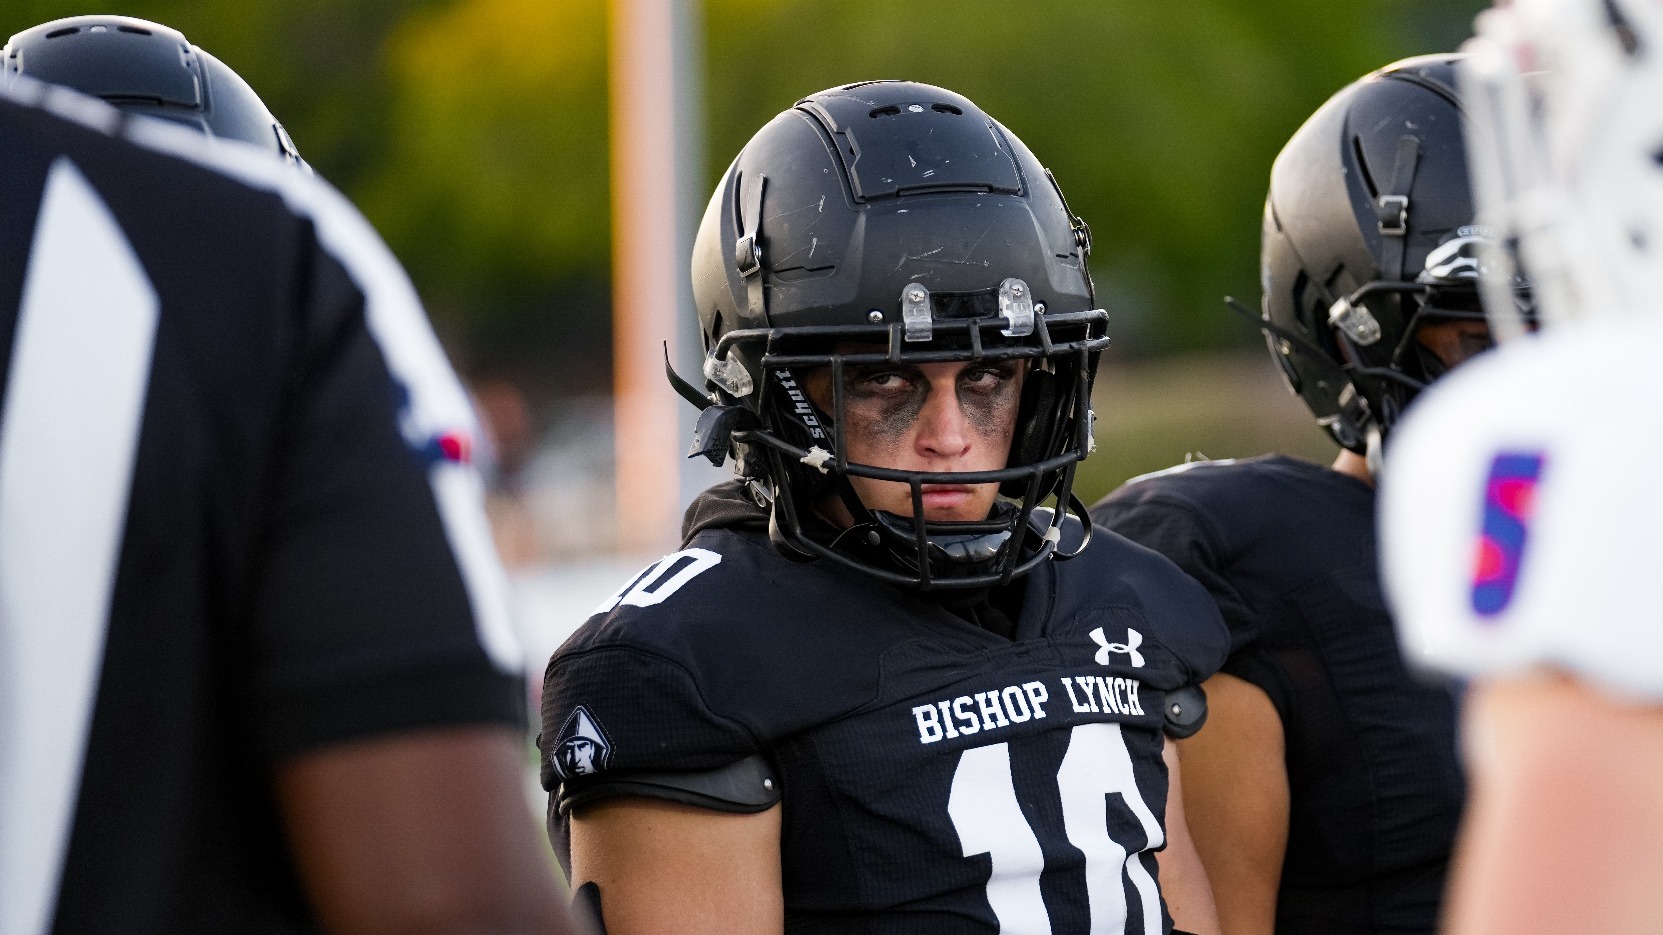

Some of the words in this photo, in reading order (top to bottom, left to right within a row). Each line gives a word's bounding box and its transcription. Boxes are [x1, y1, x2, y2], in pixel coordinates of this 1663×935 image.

[912, 680, 1048, 744] BISHOP
[1061, 676, 1144, 715] LYNCH
[948, 722, 1164, 935] 10
